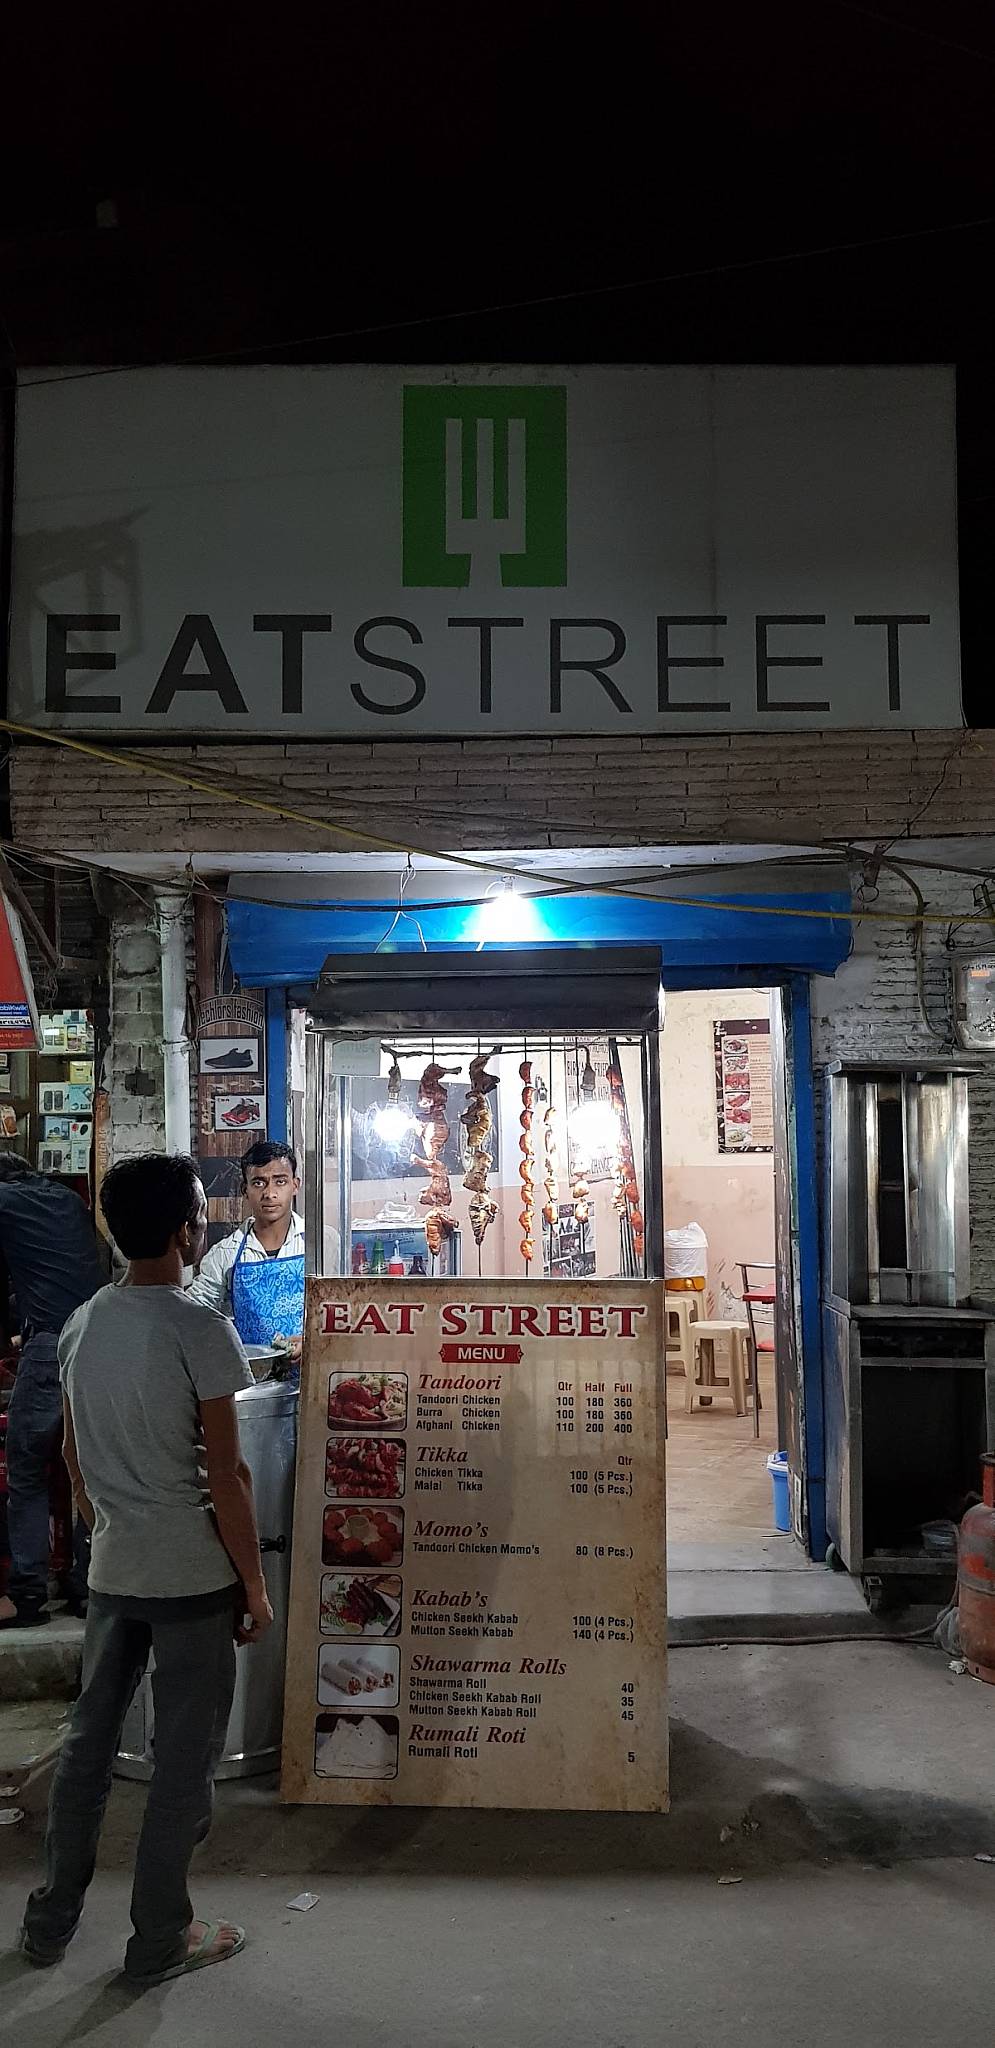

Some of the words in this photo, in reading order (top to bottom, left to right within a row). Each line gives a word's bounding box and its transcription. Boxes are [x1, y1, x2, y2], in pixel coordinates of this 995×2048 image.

[321, 1303, 424, 1335] EAT
[441, 1303, 645, 1338] STREET
[458, 1348, 505, 1360] MENU
[418, 1373, 501, 1390] Tandoori
[558, 1381, 573, 1392] Qtr
[585, 1382, 605, 1392] Half
[614, 1383, 633, 1393] Full
[416, 1394, 458, 1405] Tandoori
[462, 1395, 500, 1405] Chicken
[556, 1397, 574, 1407] 100
[586, 1397, 604, 1407] 180
[614, 1398, 632, 1408] 360
[416, 1407, 443, 1418] Burra
[462, 1408, 500, 1418] Chicken
[556, 1410, 574, 1420] 100
[586, 1410, 604, 1420] 180
[614, 1411, 632, 1421] 360
[416, 1420, 453, 1432] Afghani
[461, 1421, 500, 1431] Chicken
[556, 1422, 574, 1432] 110
[586, 1423, 604, 1433] 200
[614, 1423, 632, 1434] 400
[417, 1446, 468, 1463] Tikka
[618, 1455, 633, 1466] Qtr
[414, 1467, 453, 1478] Chicken
[457, 1468, 483, 1478] Tikka
[569, 1470, 588, 1480] 100
[594, 1470, 605, 1482] (5
[607, 1471, 633, 1483] Pcs.)
[414, 1480, 442, 1490] Malai
[457, 1481, 483, 1491] Tikka
[569, 1484, 588, 1494] 100
[594, 1484, 605, 1496] (5
[607, 1484, 633, 1496] Pcs.)
[413, 1520, 488, 1538] Momo's
[413, 1542, 455, 1553] Tandoori
[458, 1543, 498, 1554] Chicken
[501, 1544, 540, 1554] Momo's
[576, 1546, 588, 1556] 80
[594, 1546, 605, 1558] (8
[607, 1546, 634, 1559] Pcs.)
[411, 1589, 488, 1607] Kabab's
[411, 1611, 449, 1623] Chicken
[452, 1612, 484, 1623] Seekh
[487, 1613, 518, 1625] Kabab
[572, 1616, 591, 1626] 100
[594, 1616, 606, 1628] (4
[608, 1616, 634, 1629] Pcs.)
[411, 1625, 446, 1636] Mutton
[448, 1626, 479, 1637] Seekh
[482, 1627, 513, 1638] Kabab
[572, 1629, 591, 1640] 140
[594, 1629, 606, 1642] (4
[608, 1630, 634, 1642] Pcs.)
[410, 1655, 511, 1673] Shawarma
[519, 1657, 567, 1675] Rolls
[410, 1677, 464, 1688] Shawarma
[466, 1678, 487, 1688] Roll
[621, 1683, 634, 1693] 40
[410, 1691, 448, 1702] Chicken
[452, 1692, 483, 1703] Seekh
[486, 1692, 518, 1704] Kabab
[520, 1693, 541, 1704] Roll
[621, 1696, 634, 1706] 35
[409, 1704, 445, 1715] Mutton
[447, 1705, 478, 1716] Seekh
[481, 1706, 513, 1717] Kabab
[516, 1707, 536, 1718] Roll
[621, 1710, 634, 1721] 45
[409, 1724, 479, 1742] Rumali
[486, 1726, 527, 1744] Roti
[408, 1745, 451, 1757] Rumali
[454, 1747, 478, 1758] Roti
[628, 1751, 635, 1762] 5
